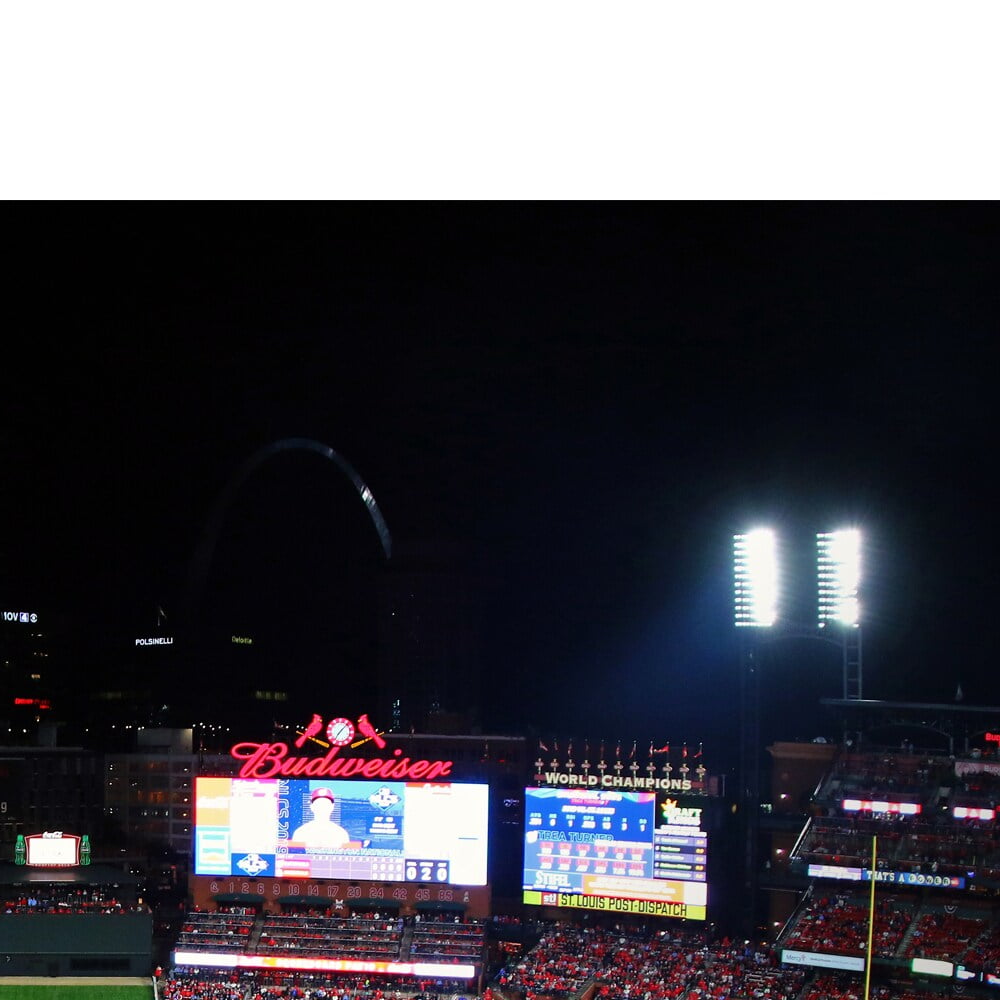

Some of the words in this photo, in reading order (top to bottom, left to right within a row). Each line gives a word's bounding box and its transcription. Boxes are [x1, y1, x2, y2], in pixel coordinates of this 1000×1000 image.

[135, 637, 173, 646] POLSINELLI
[231, 741, 453, 779] Budweiser
[545, 772, 598, 787] WORLD
[601, 774, 692, 790] CHAMPIONS
[899, 872, 905, 883] A
[288, 884, 300, 895] 10
[307, 885, 320, 896] 14
[327, 886, 340, 897] 17
[347, 886, 361, 897] 20
[369, 887, 384, 898] 24
[393, 888, 407, 899] 42
[561, 895, 574, 906] ST.
[577, 896, 605, 909] LOUIS
[609, 897, 687, 916] POST-DISPATCH
